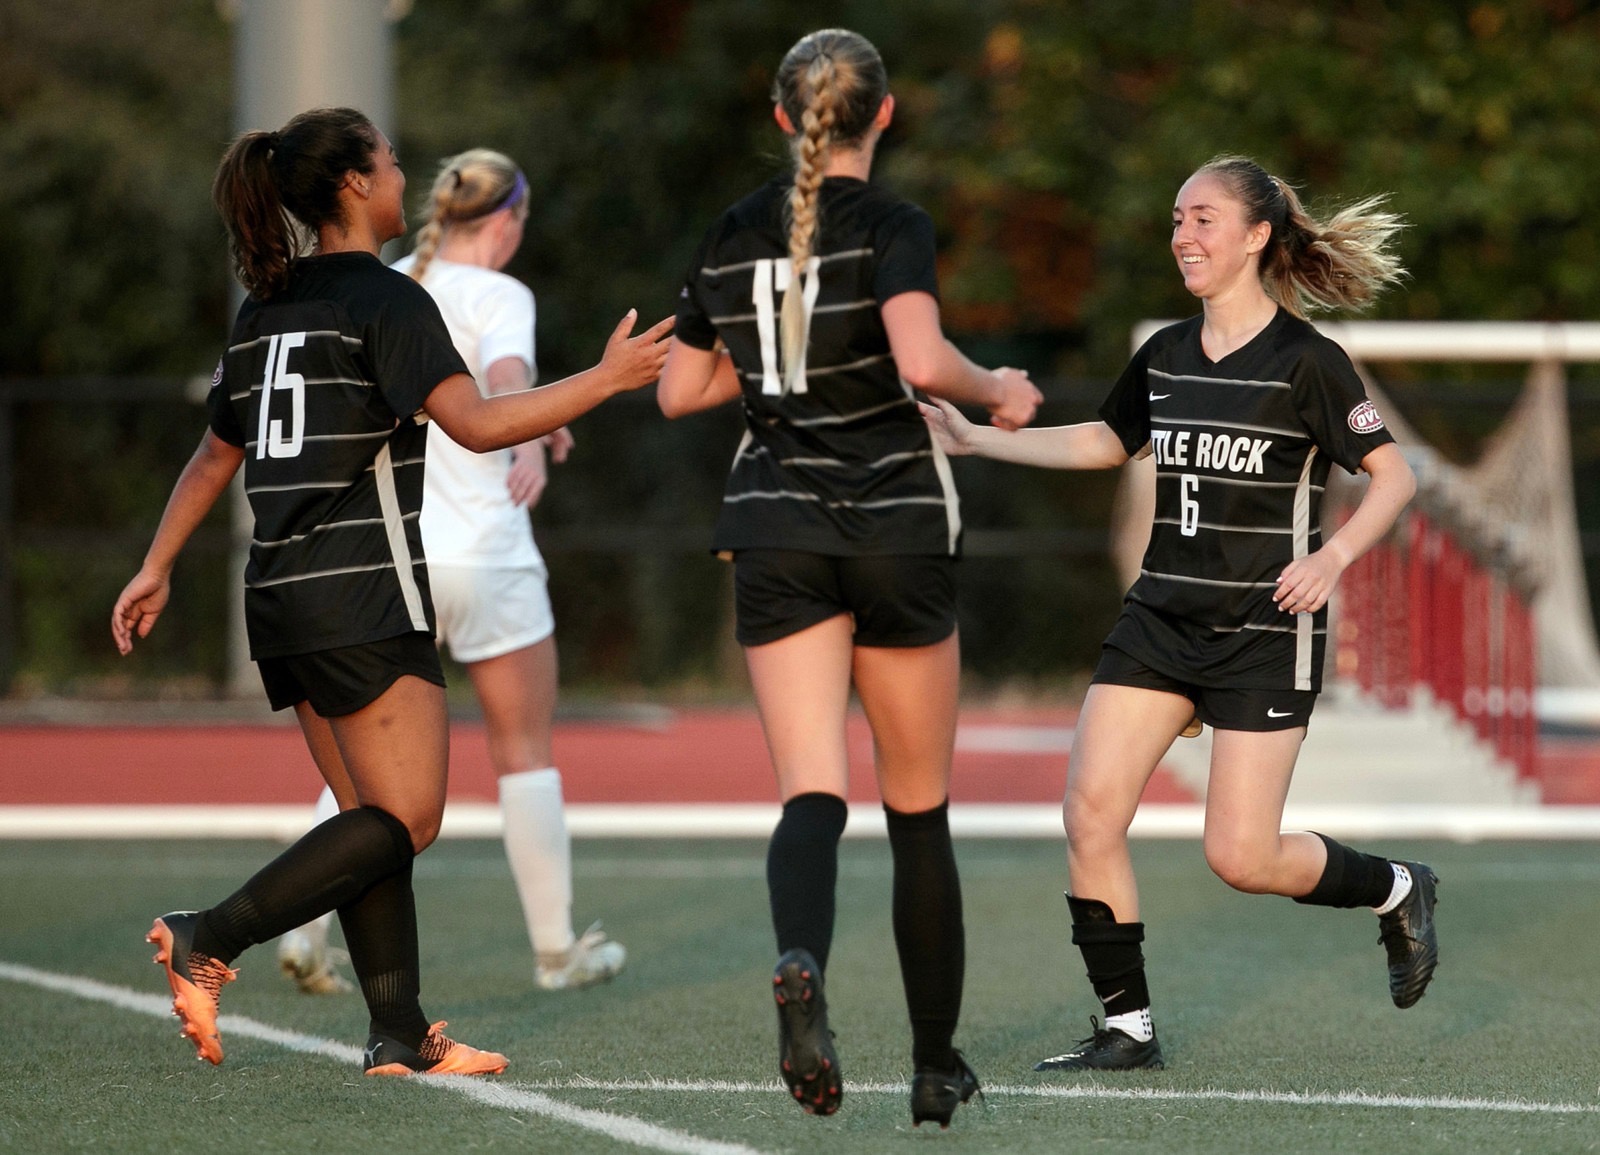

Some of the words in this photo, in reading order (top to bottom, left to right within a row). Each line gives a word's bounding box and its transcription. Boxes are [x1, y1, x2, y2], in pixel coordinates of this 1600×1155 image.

[256, 331, 306, 460] 15
[1150, 429, 1191, 466] TTLE
[1195, 433, 1273, 474] ROCK
[1180, 473, 1200, 537] 6
